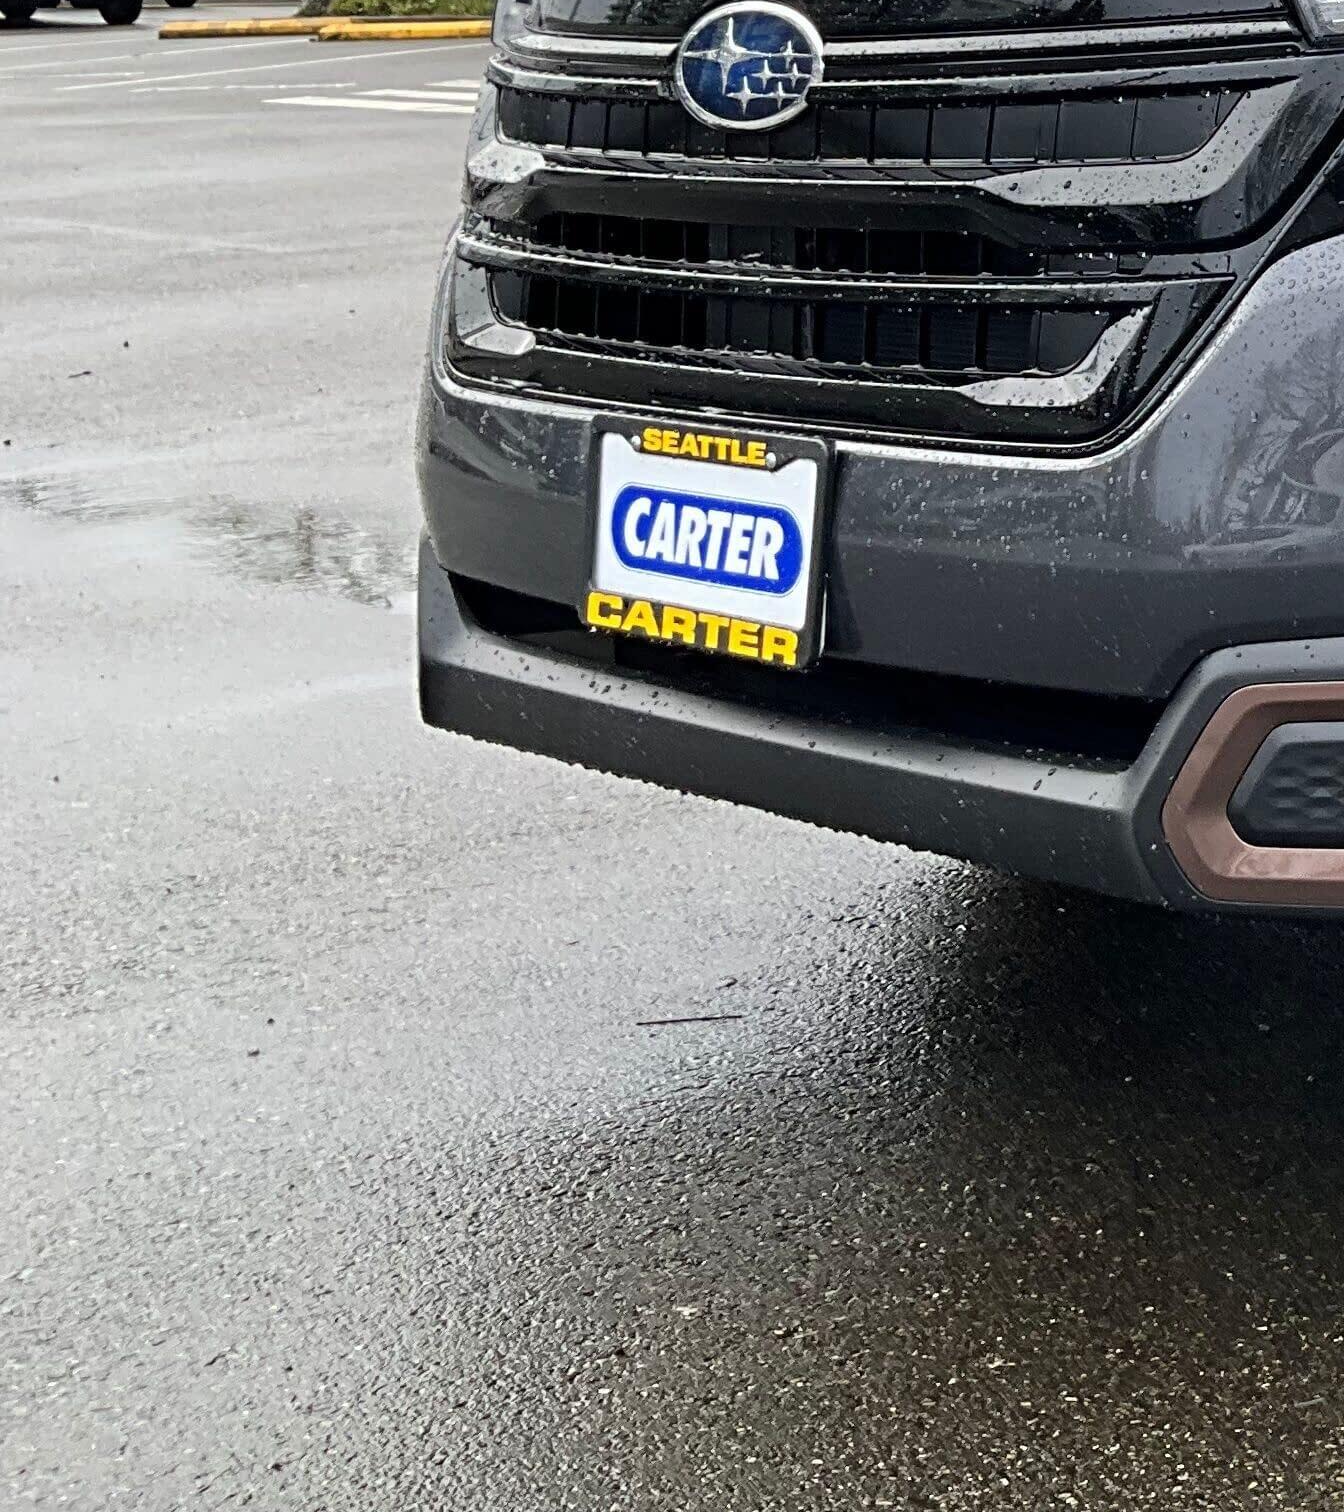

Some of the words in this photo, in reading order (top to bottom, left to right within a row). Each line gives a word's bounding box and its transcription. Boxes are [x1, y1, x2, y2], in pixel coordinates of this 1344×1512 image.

[642, 427, 767, 467] SEATTLE
[623, 496, 785, 581] CARTER
[585, 591, 799, 666] CARTER
